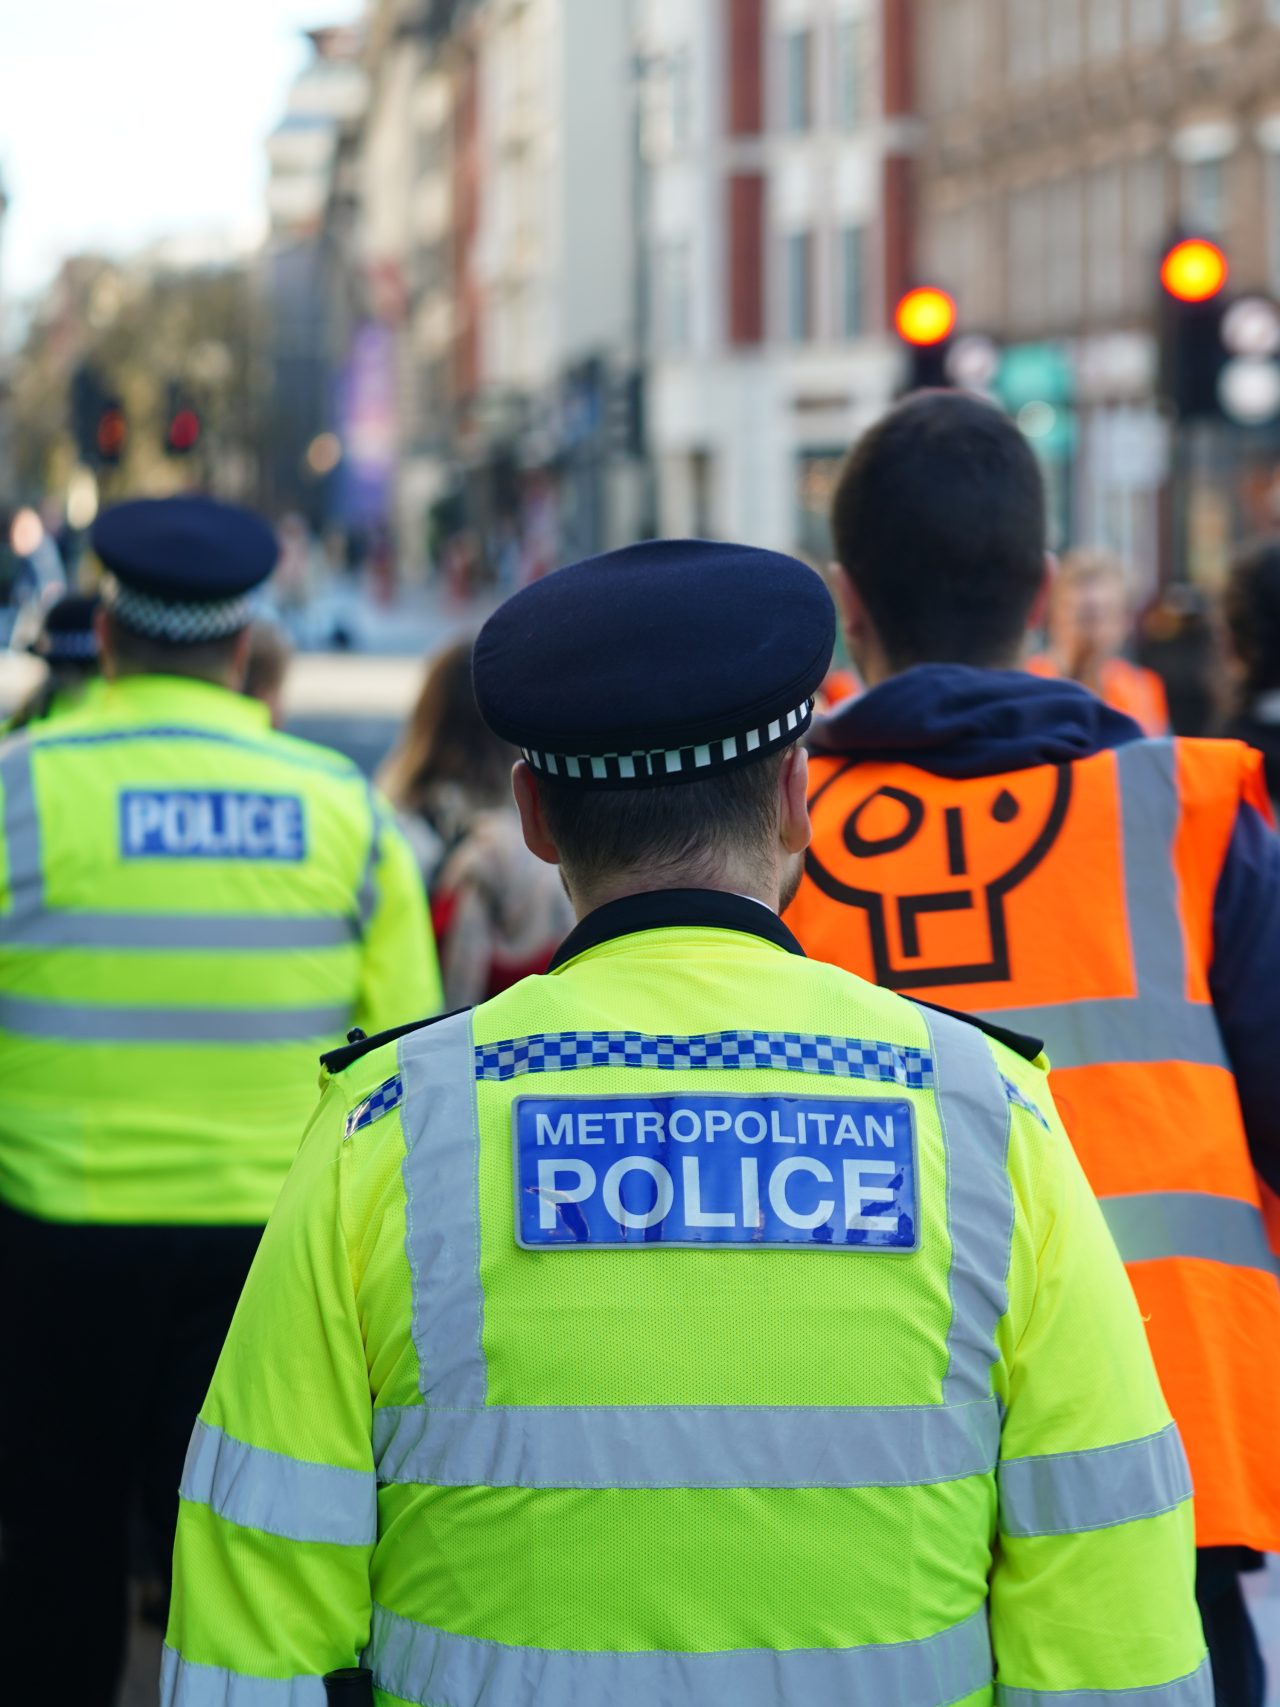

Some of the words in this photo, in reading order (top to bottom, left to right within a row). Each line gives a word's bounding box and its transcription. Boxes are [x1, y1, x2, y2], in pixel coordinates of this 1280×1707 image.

[125, 791, 301, 856] POLICE
[535, 1109, 895, 1148] METROPOLITAN
[537, 1155, 898, 1230] POLICE
